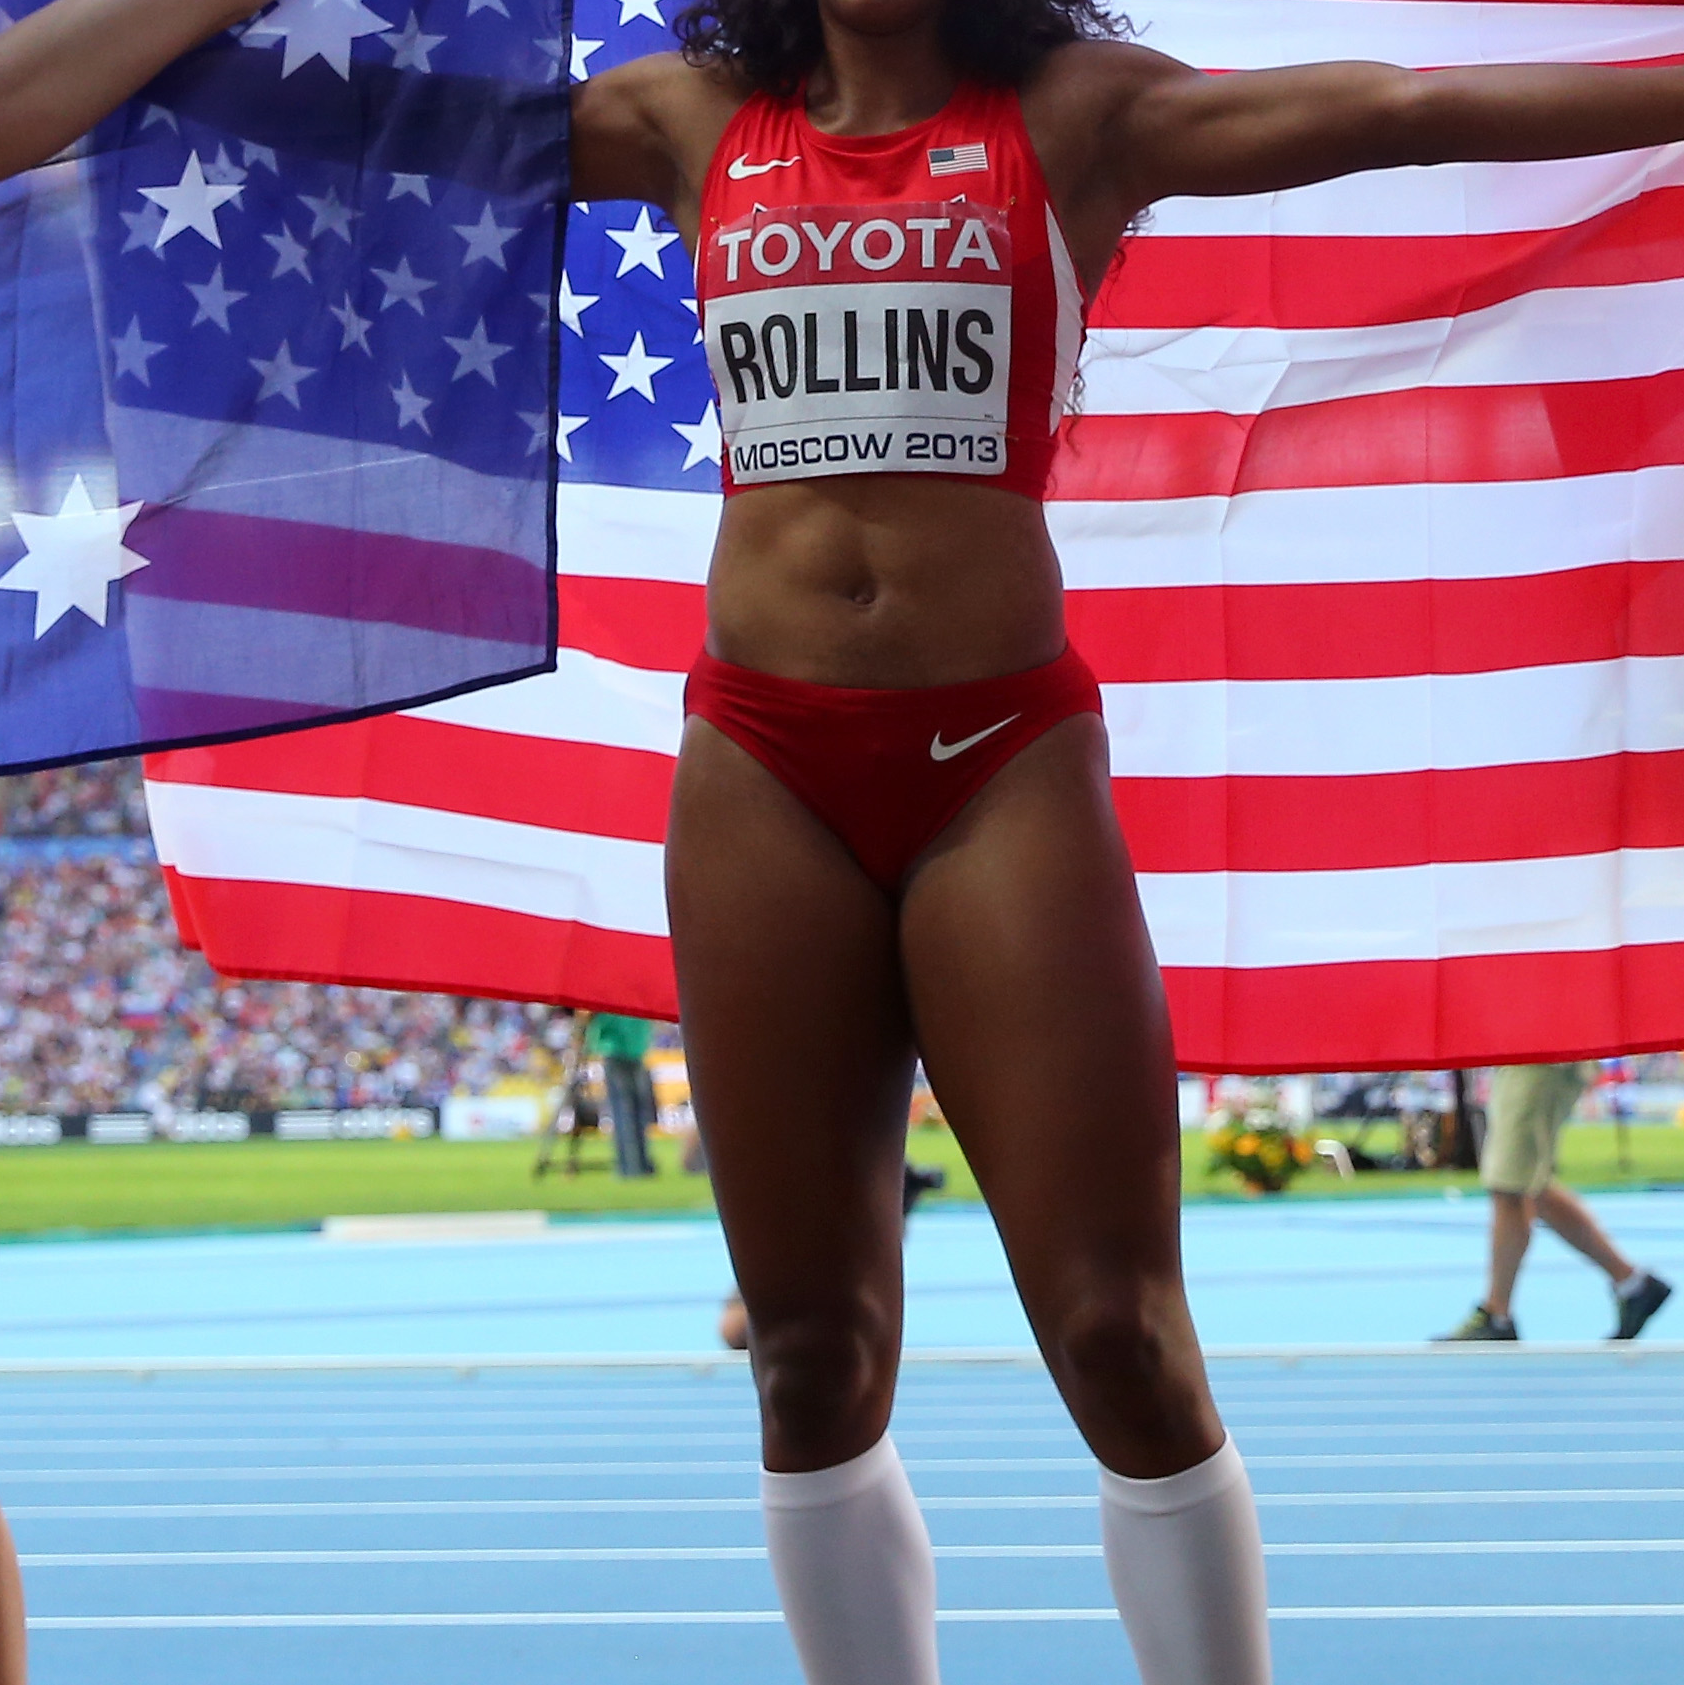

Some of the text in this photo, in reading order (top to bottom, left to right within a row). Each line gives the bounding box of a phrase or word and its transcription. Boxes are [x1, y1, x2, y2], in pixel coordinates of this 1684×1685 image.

[717, 217, 1002, 282] TOYOTA
[719, 308, 995, 403] ROLLINS
[733, 431, 999, 473] MOSCOW 2013
